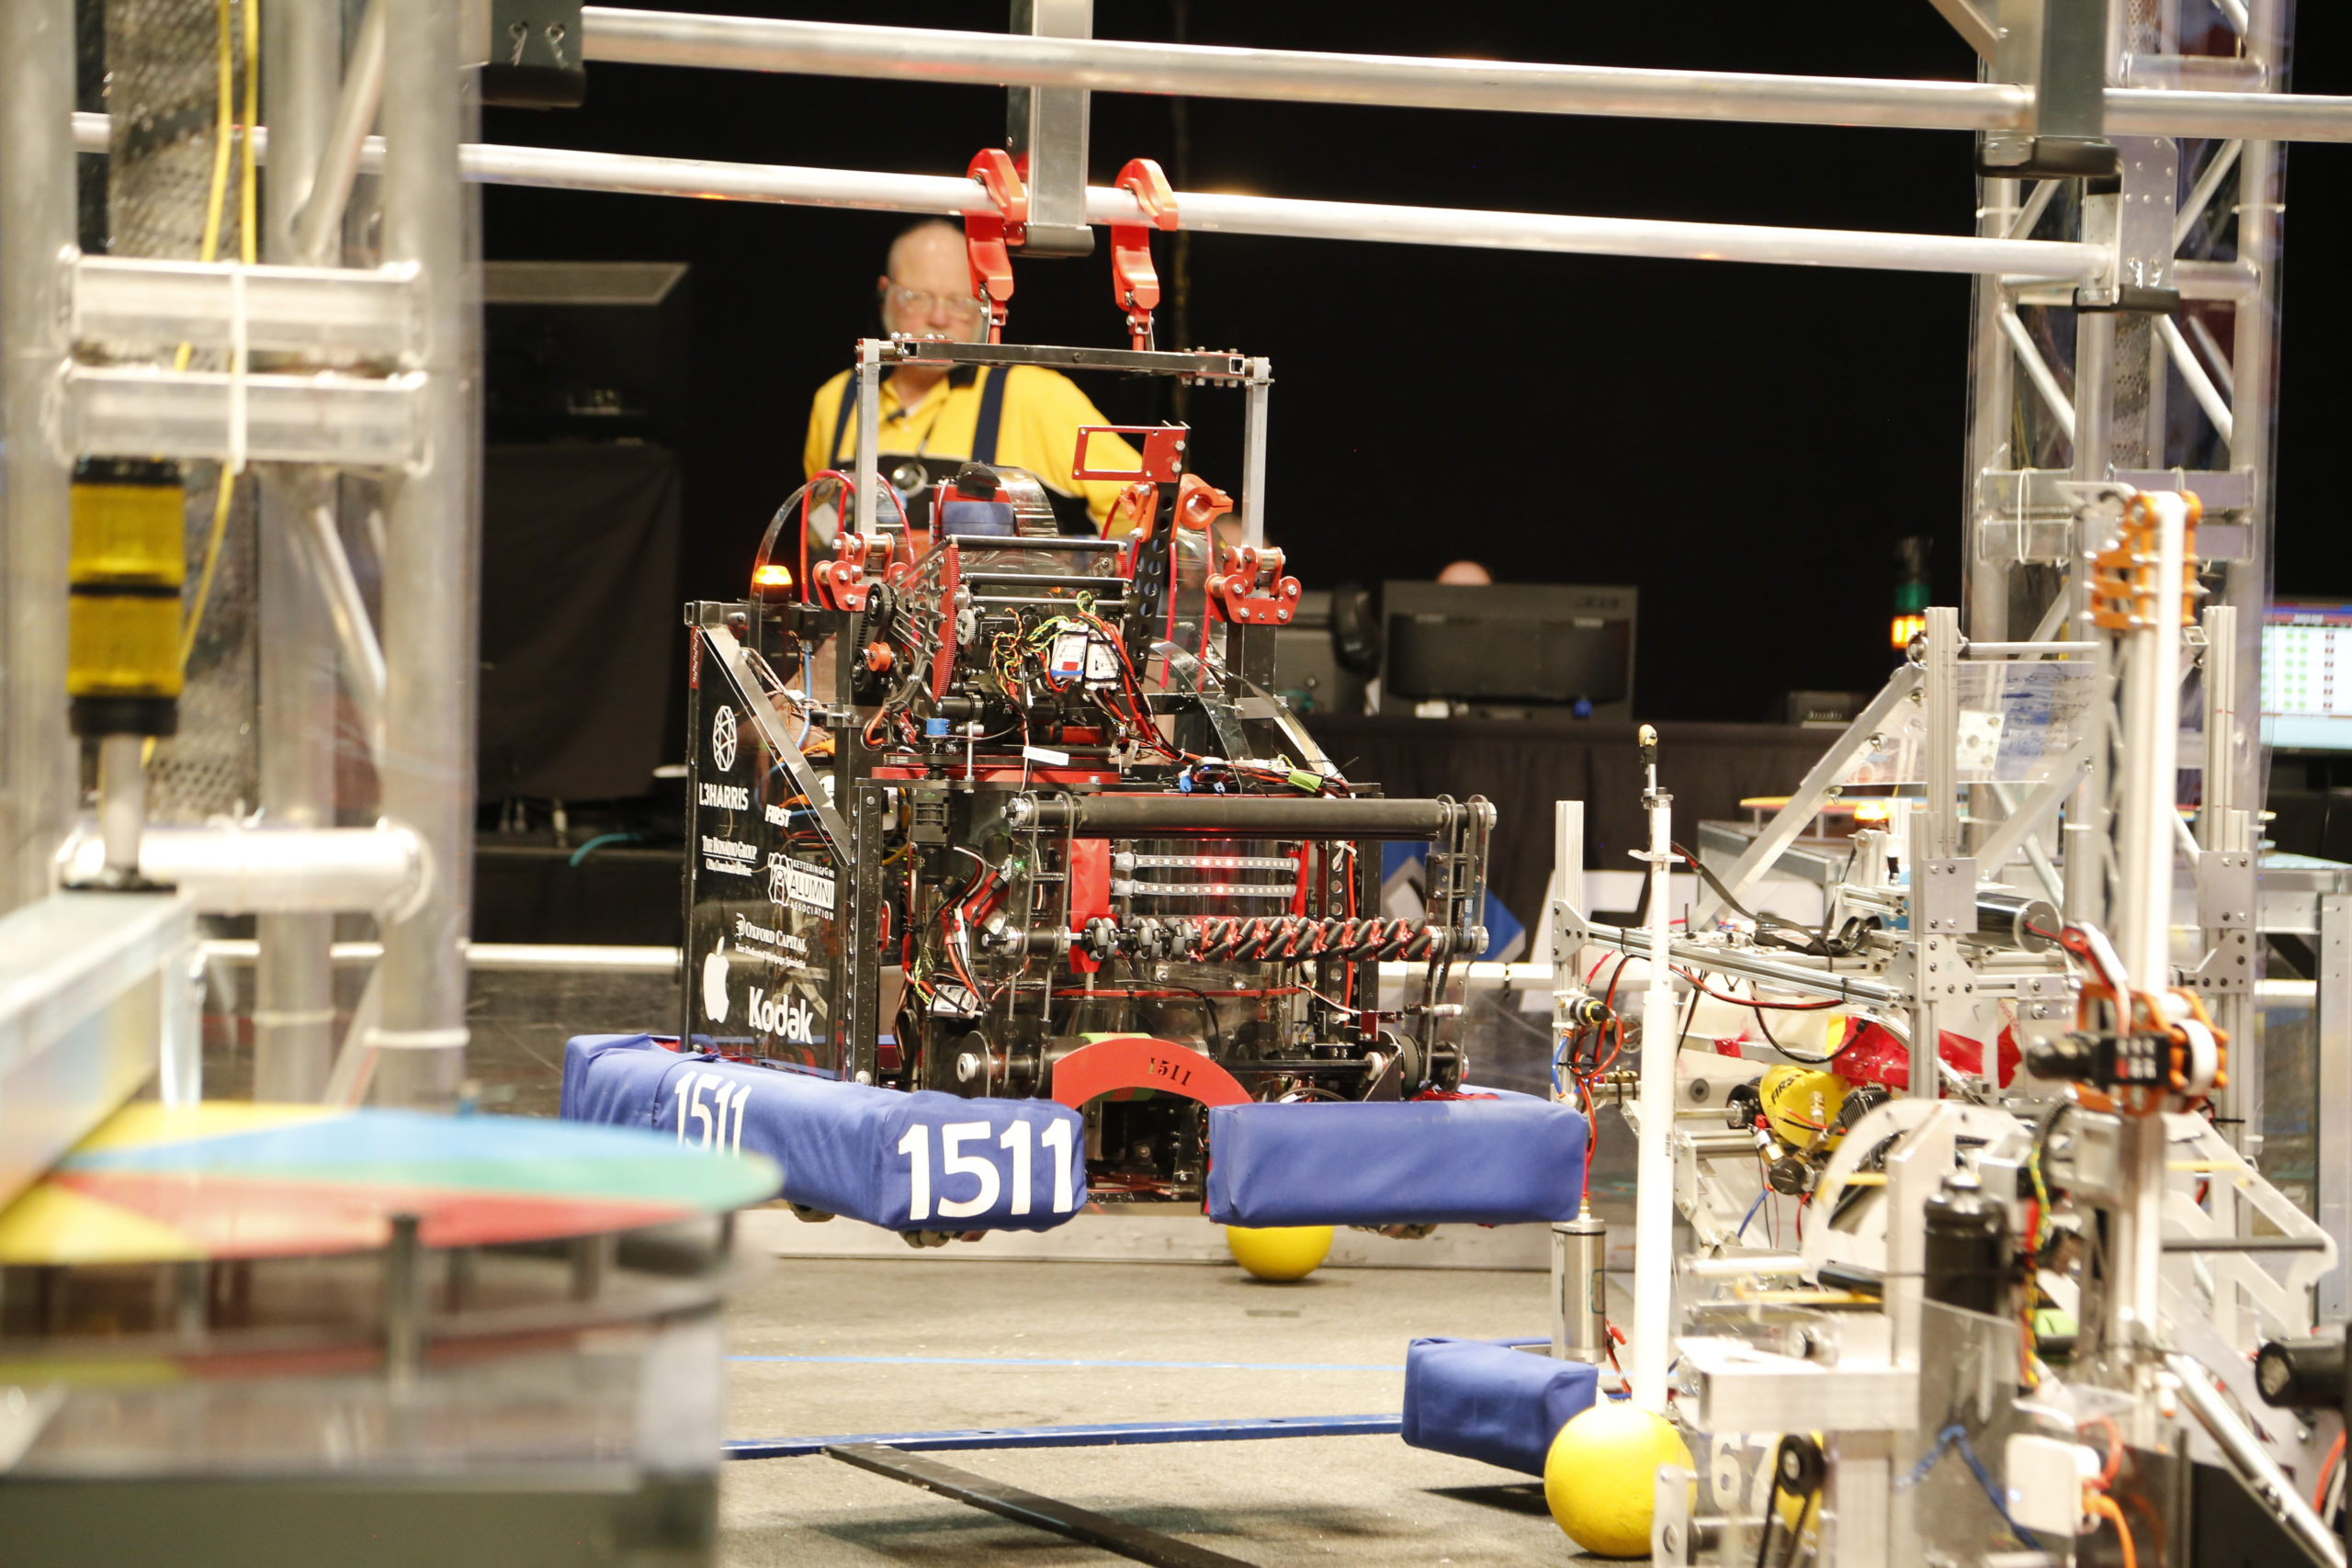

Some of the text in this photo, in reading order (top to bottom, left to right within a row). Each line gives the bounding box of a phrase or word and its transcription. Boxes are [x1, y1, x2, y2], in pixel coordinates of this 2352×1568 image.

[699, 783, 749, 811] L3HARRIS
[764, 804, 792, 828] FIRST
[789, 874, 833, 906] ALUMNI
[789, 901, 834, 921] ASSOCIATION
[748, 986, 814, 1044] Kodak
[1148, 1057, 1192, 1087] 1511
[674, 1070, 752, 1159] 1511
[898, 1117, 1073, 1221] 1511
